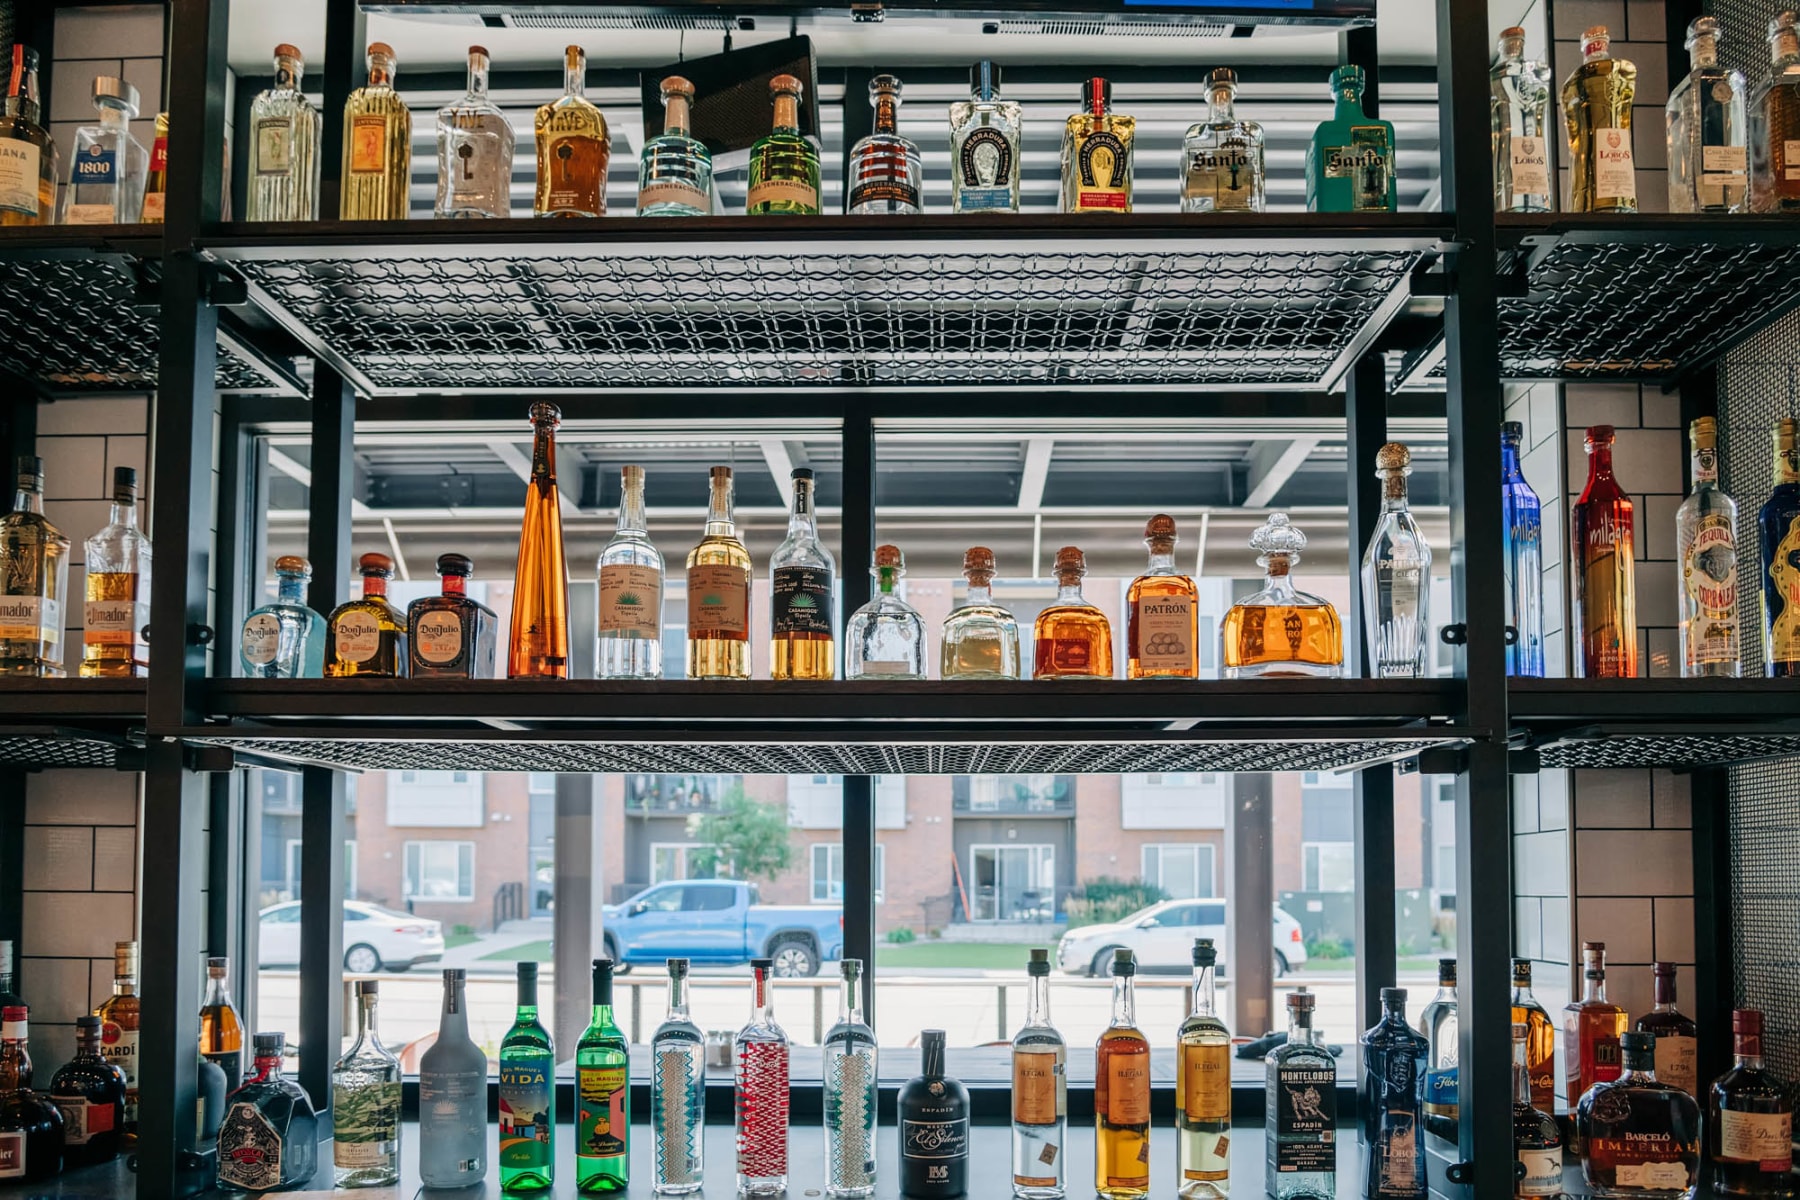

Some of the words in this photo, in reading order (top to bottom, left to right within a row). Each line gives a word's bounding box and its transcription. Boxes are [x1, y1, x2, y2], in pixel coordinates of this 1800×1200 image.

[964, 131, 1008, 151] HERRADURA
[1083, 136, 1122, 154] HERRADURA
[1192, 150, 1248, 172] Santo
[1329, 150, 1383, 172] Santo
[1514, 156, 1544, 165] LOBOS
[1600, 150, 1630, 160] LOBOS
[79, 162, 110, 174] 1800
[1700, 527, 1730, 547] TEQUILA
[1144, 602, 1186, 614] PATRÓN
[501, 1073, 545, 1084] VIDA
[1281, 1071, 1334, 1081] MONTELOBOS
[1292, 1121, 1323, 1129] ESPADÍN
[1625, 1131, 1671, 1142] BARCELÓ
[1382, 1145, 1419, 1158] LOBOS
[1598, 1139, 1696, 1153] IMPERIAL
